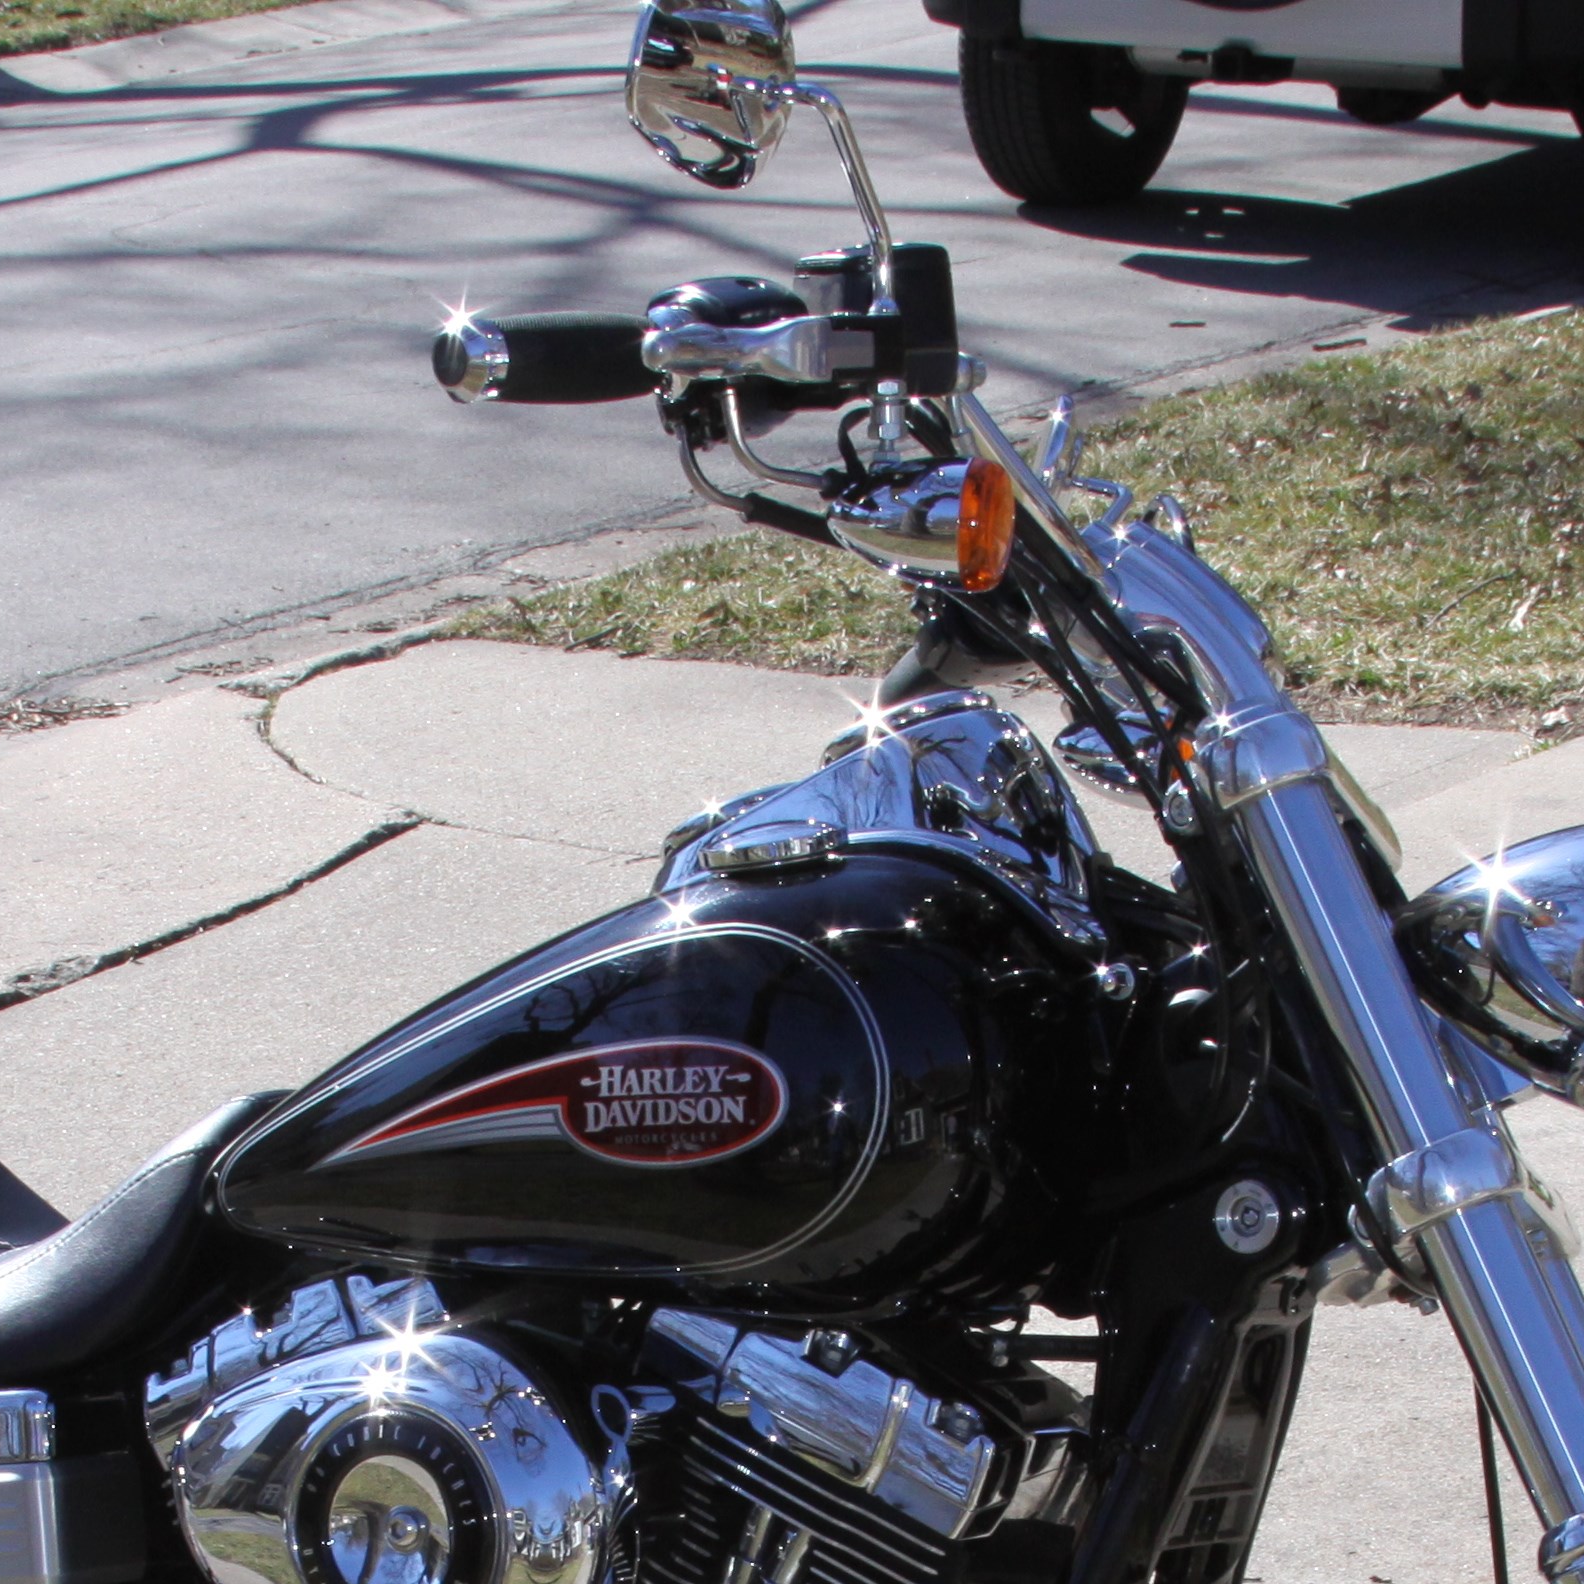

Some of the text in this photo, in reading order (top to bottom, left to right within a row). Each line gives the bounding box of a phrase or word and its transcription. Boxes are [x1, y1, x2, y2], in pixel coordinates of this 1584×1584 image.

[598, 1065, 729, 1098] HARLEY
[584, 1096, 746, 1133] DAVIDSON
[615, 1131, 718, 1145] MOTORCYCLES
[332, 1424, 402, 1457] CUBIC
[417, 1435, 477, 1526] INCHES
